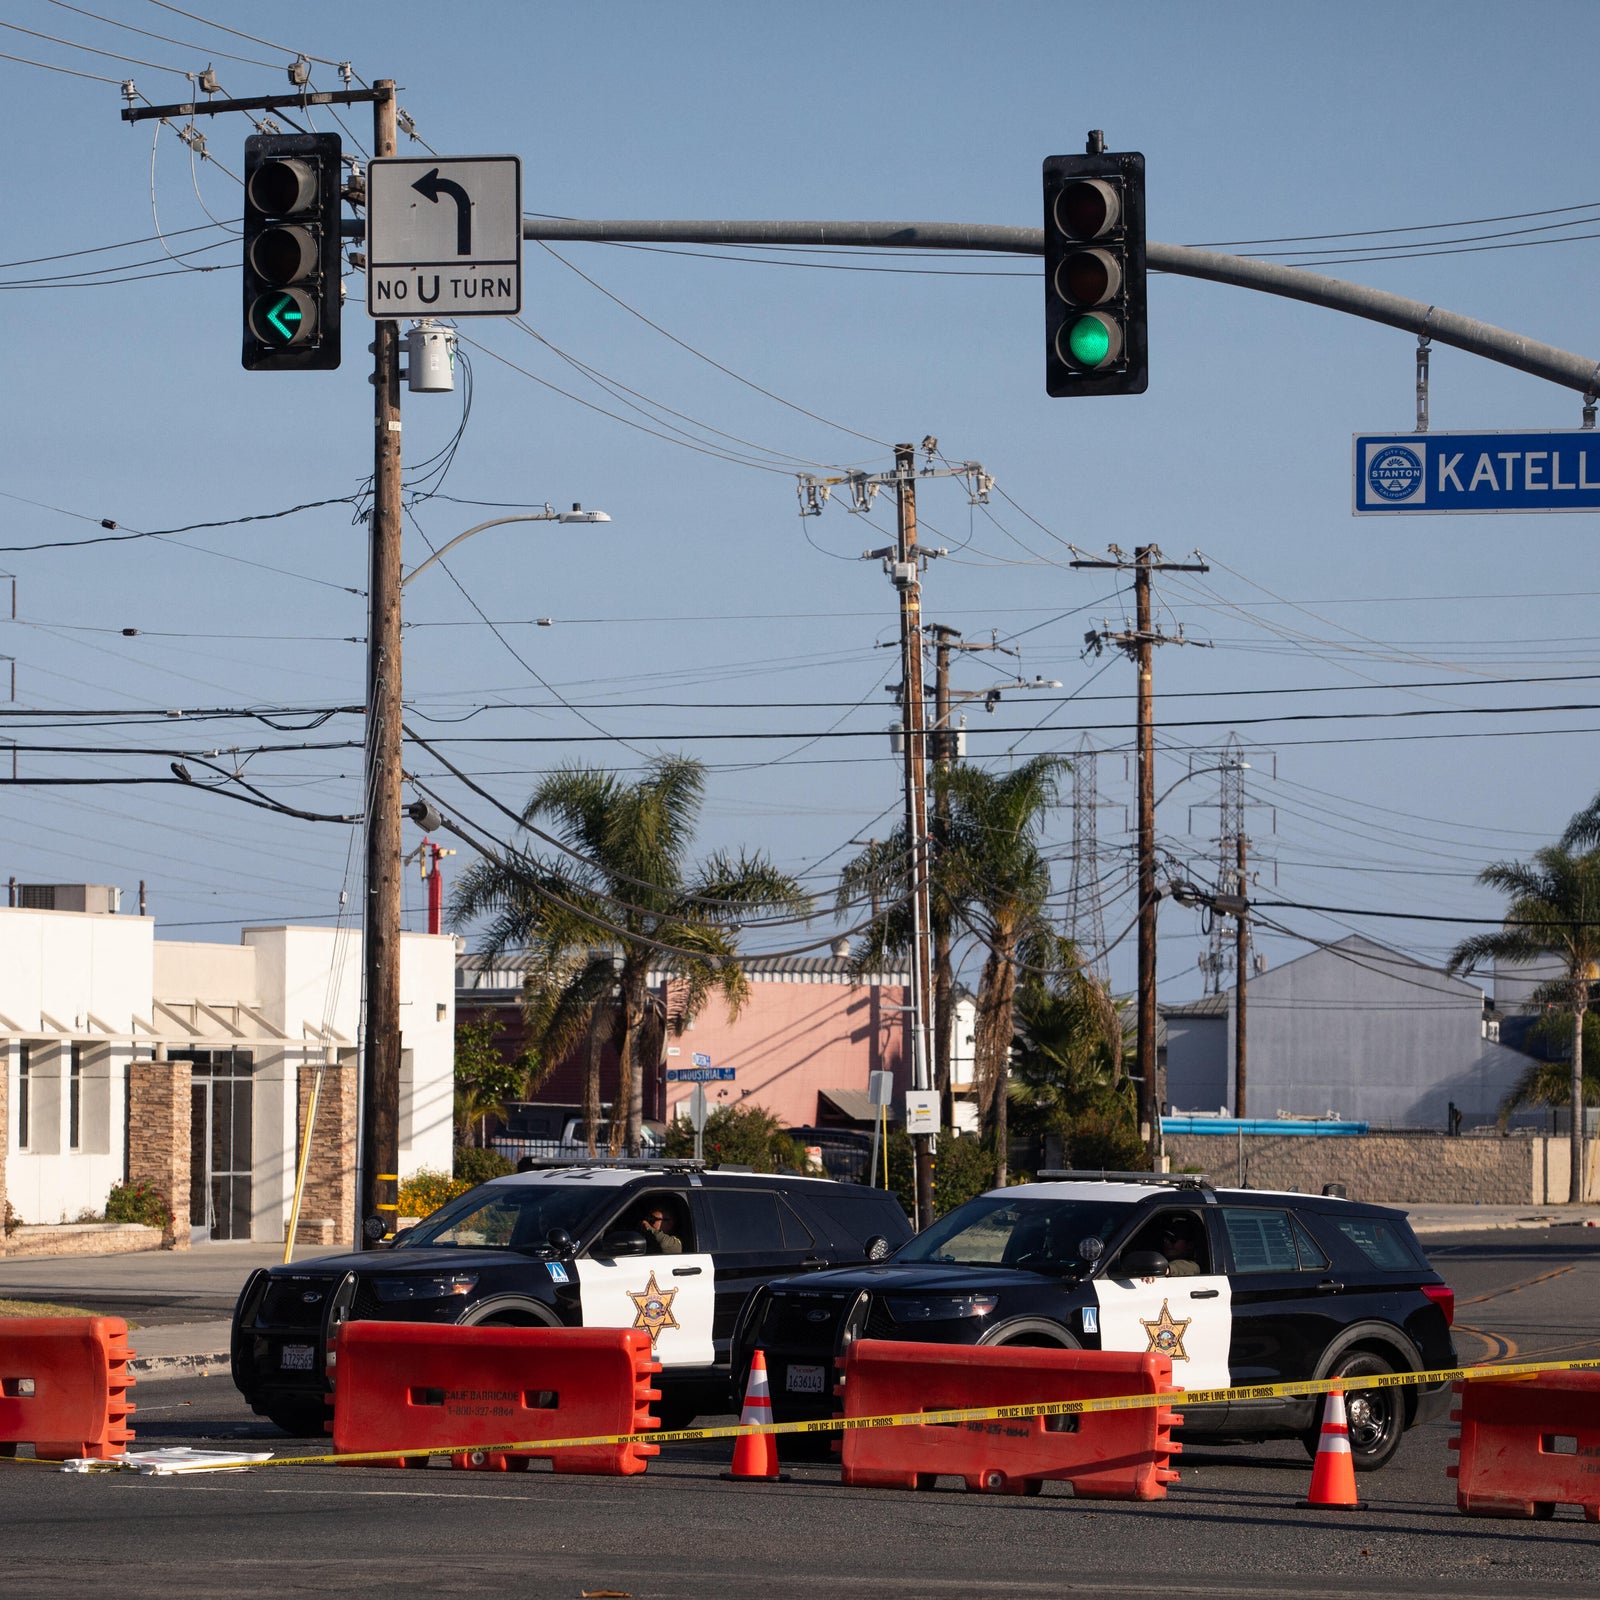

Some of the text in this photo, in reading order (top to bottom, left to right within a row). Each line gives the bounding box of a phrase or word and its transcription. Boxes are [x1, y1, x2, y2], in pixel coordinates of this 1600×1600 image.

[378, 276, 511, 304] NO U TURN
[1372, 470, 1420, 478] STANTON
[680, 1068, 721, 1080] INDUSTRIAL
[790, 1375, 822, 1388] 1636143
[1378, 1377, 1400, 1386] POLICE
[1402, 1376, 1416, 1384] LINE
[1443, 1372, 1464, 1380] CROSS
[470, 1391, 519, 1401] BARRICADE
[1188, 1387, 1273, 1402] POLICE LINE DO NOT CROSS
[998, 1403, 1083, 1417] POLICE LINE DO NOT CROSS
[808, 1423, 829, 1431] POLICE
[831, 1421, 845, 1429] LINE
[872, 1417, 893, 1426] CROSS
